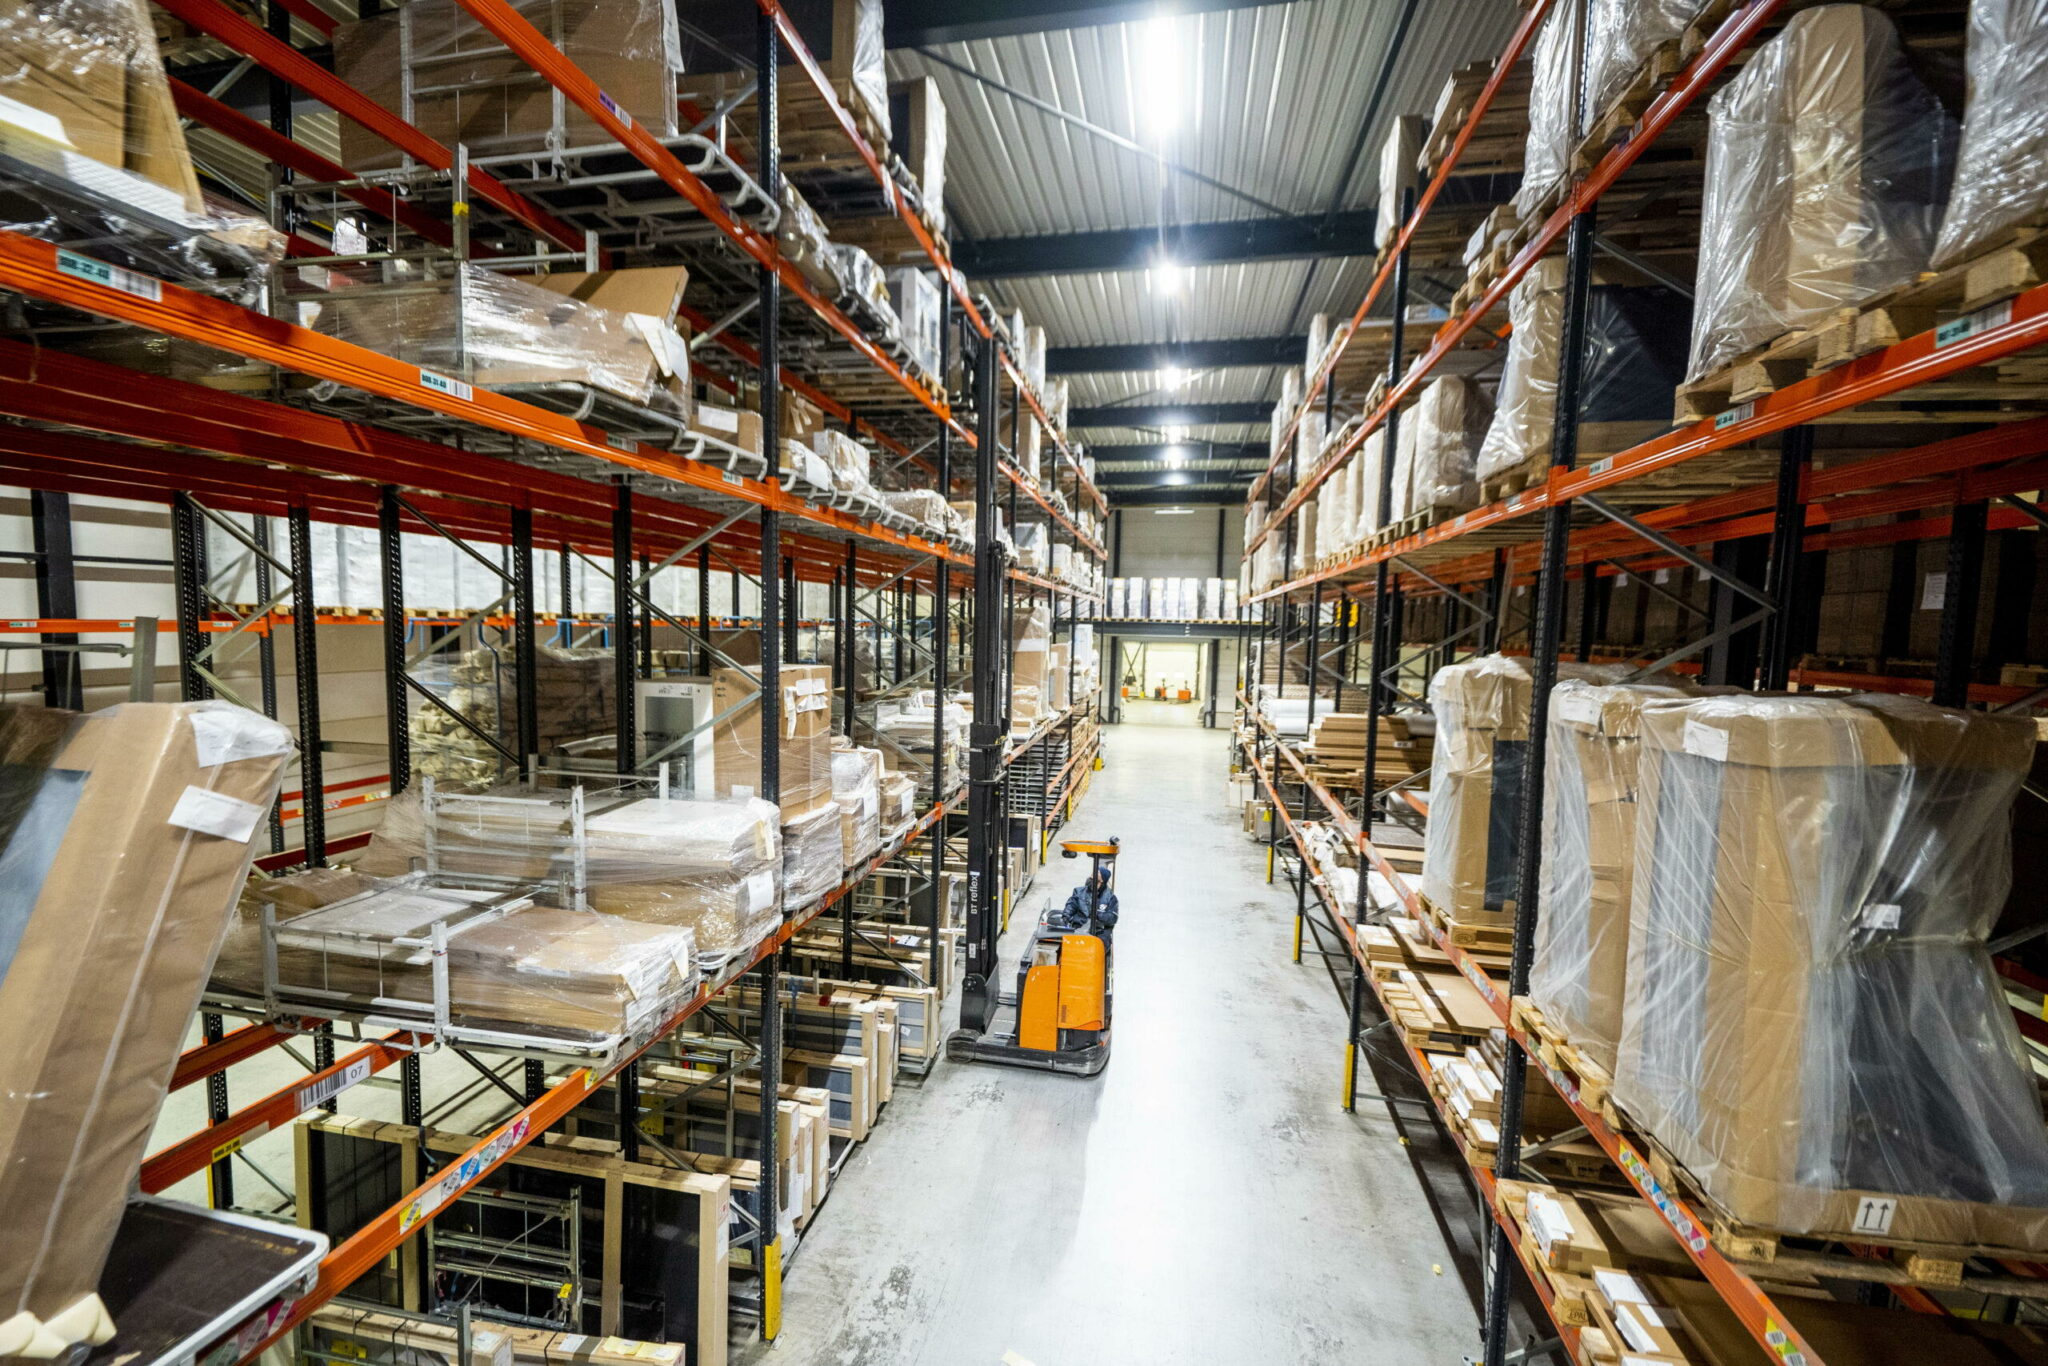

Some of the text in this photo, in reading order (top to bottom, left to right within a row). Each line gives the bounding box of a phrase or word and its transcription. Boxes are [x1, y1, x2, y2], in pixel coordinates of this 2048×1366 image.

[969, 875, 978, 915] BT reflex
[350, 1065, 363, 1079] 07
